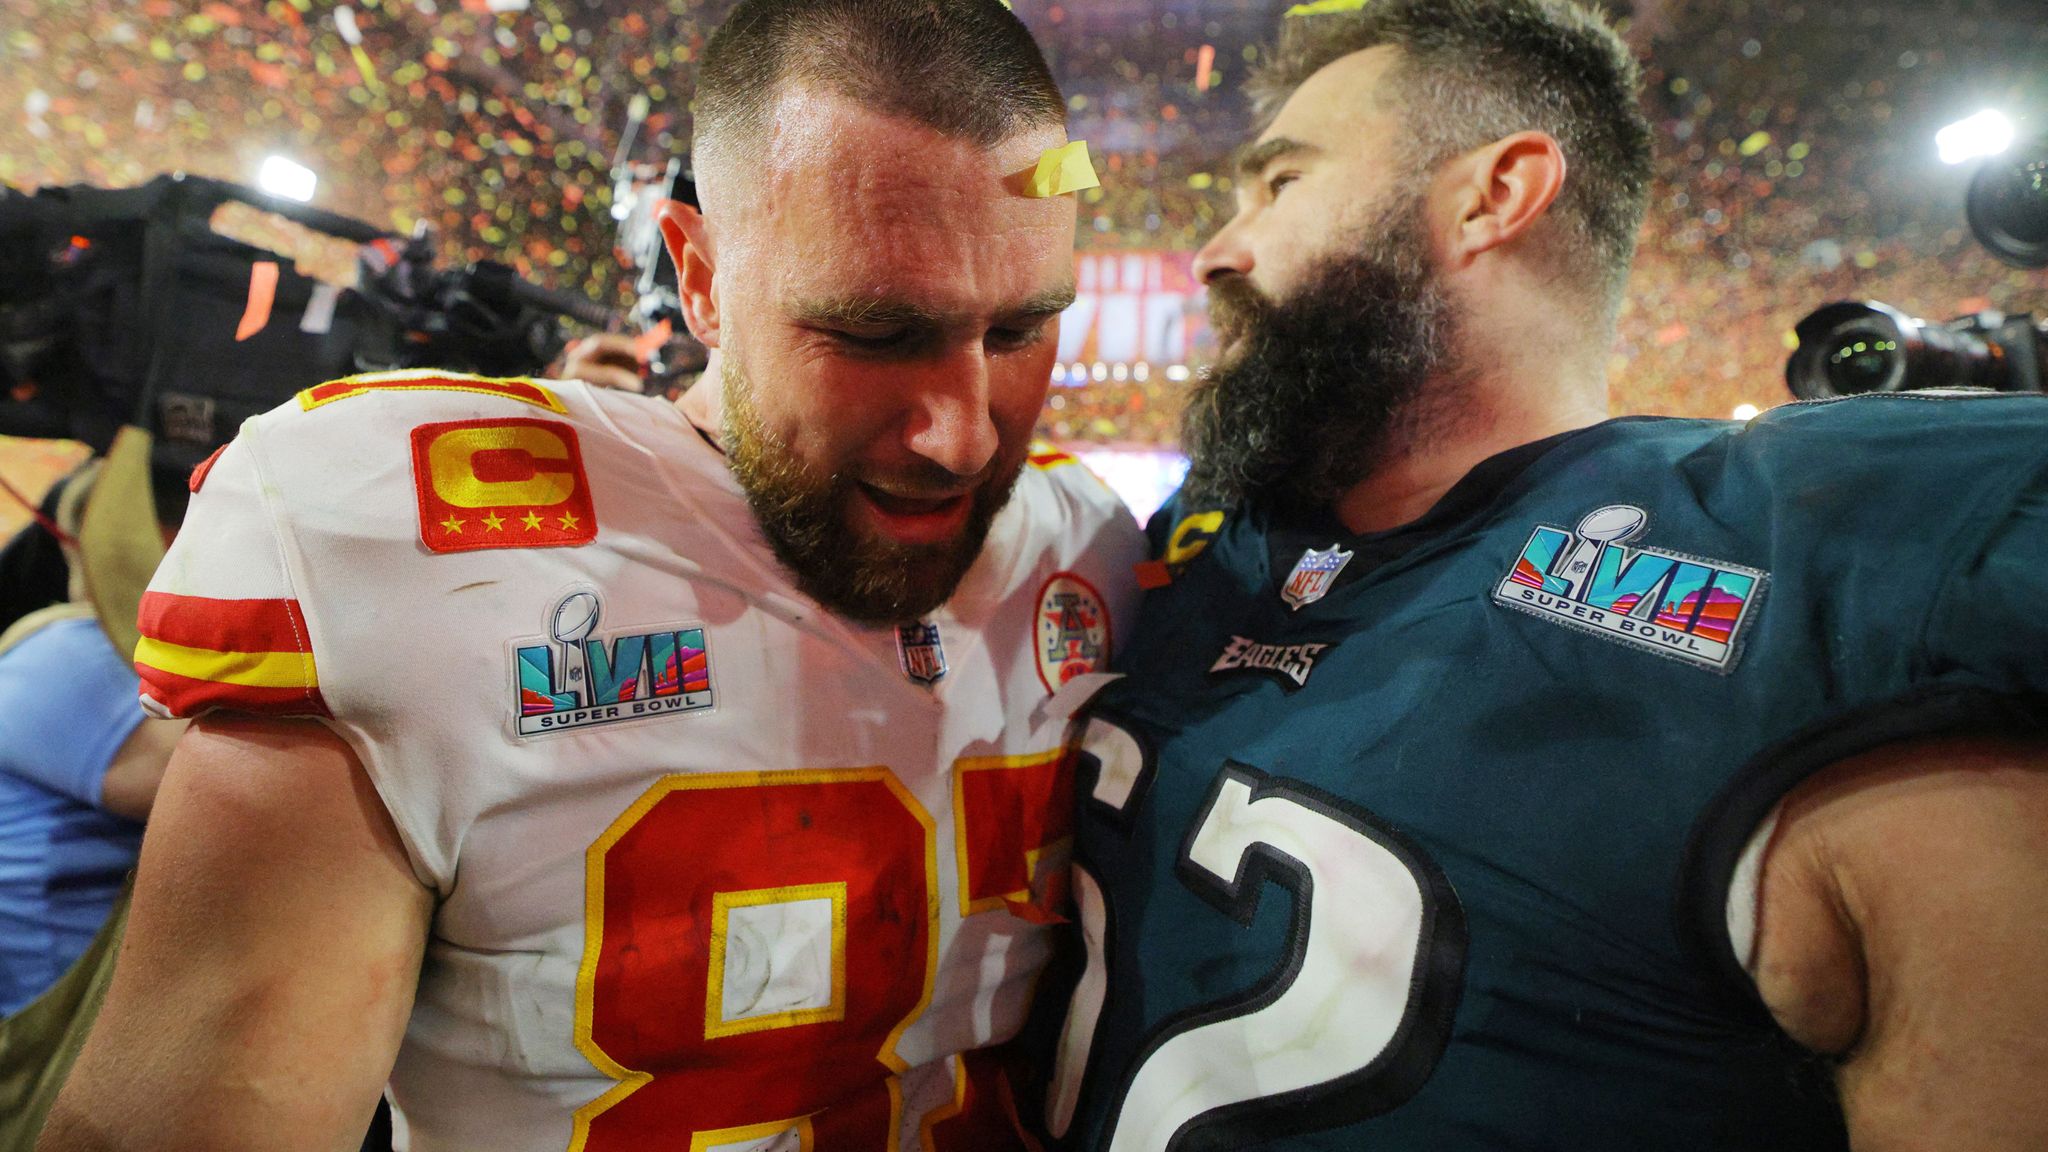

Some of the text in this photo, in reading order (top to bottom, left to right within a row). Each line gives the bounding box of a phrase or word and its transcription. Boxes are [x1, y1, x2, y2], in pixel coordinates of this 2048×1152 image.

[429, 426, 574, 508] C
[1288, 569, 1326, 597] NFL
[1511, 528, 1756, 643] LVII
[1521, 589, 1701, 651] SUPER BOWL
[516, 628, 710, 717] LVII
[1209, 635, 1329, 686] EAGLES
[540, 696, 697, 728] SUPER BOWL
